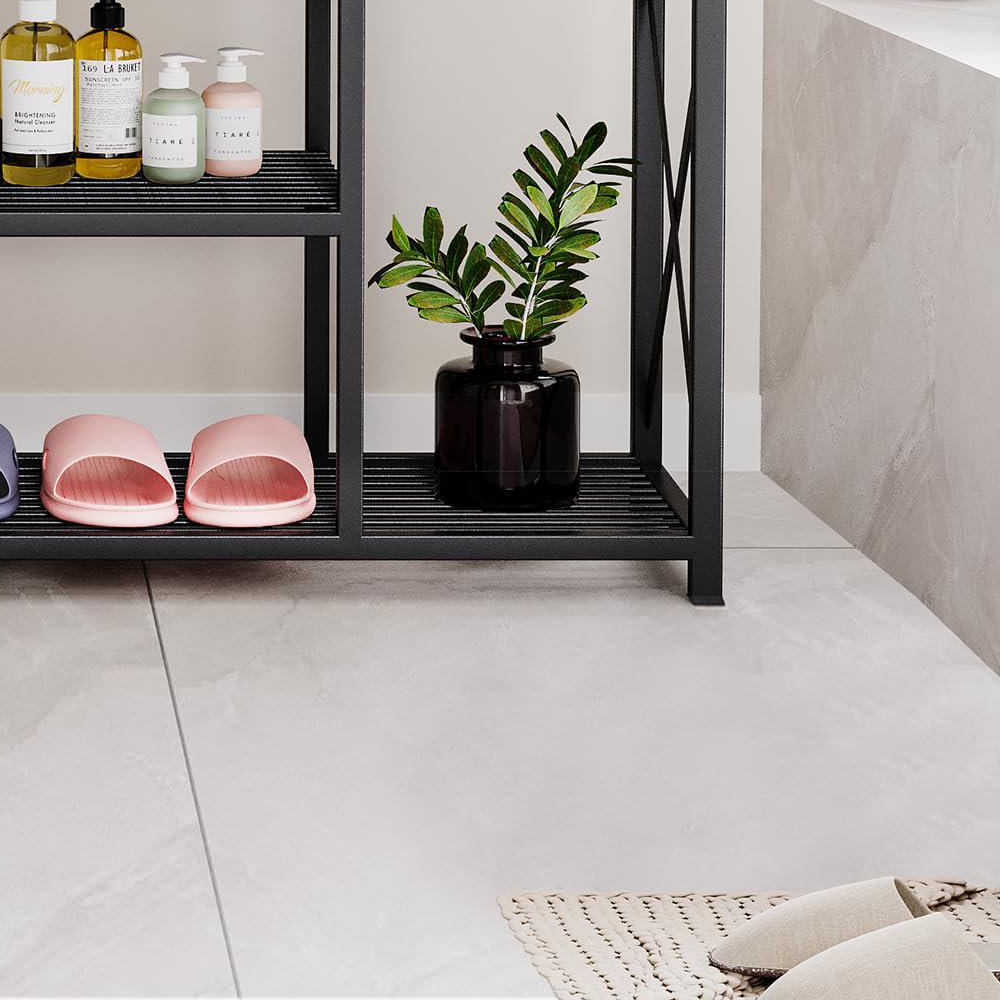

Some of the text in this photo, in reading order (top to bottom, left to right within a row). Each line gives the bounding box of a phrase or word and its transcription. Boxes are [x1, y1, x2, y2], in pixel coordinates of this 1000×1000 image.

[82, 64, 98, 73] 169
[118, 62, 141, 73] BRUKET
[7, 79, 65, 104] Morning
[14, 111, 56, 119] BRIGHTENING
[215, 130, 251, 138] TIARÉ
[149, 137, 183, 145] TIARÉ
